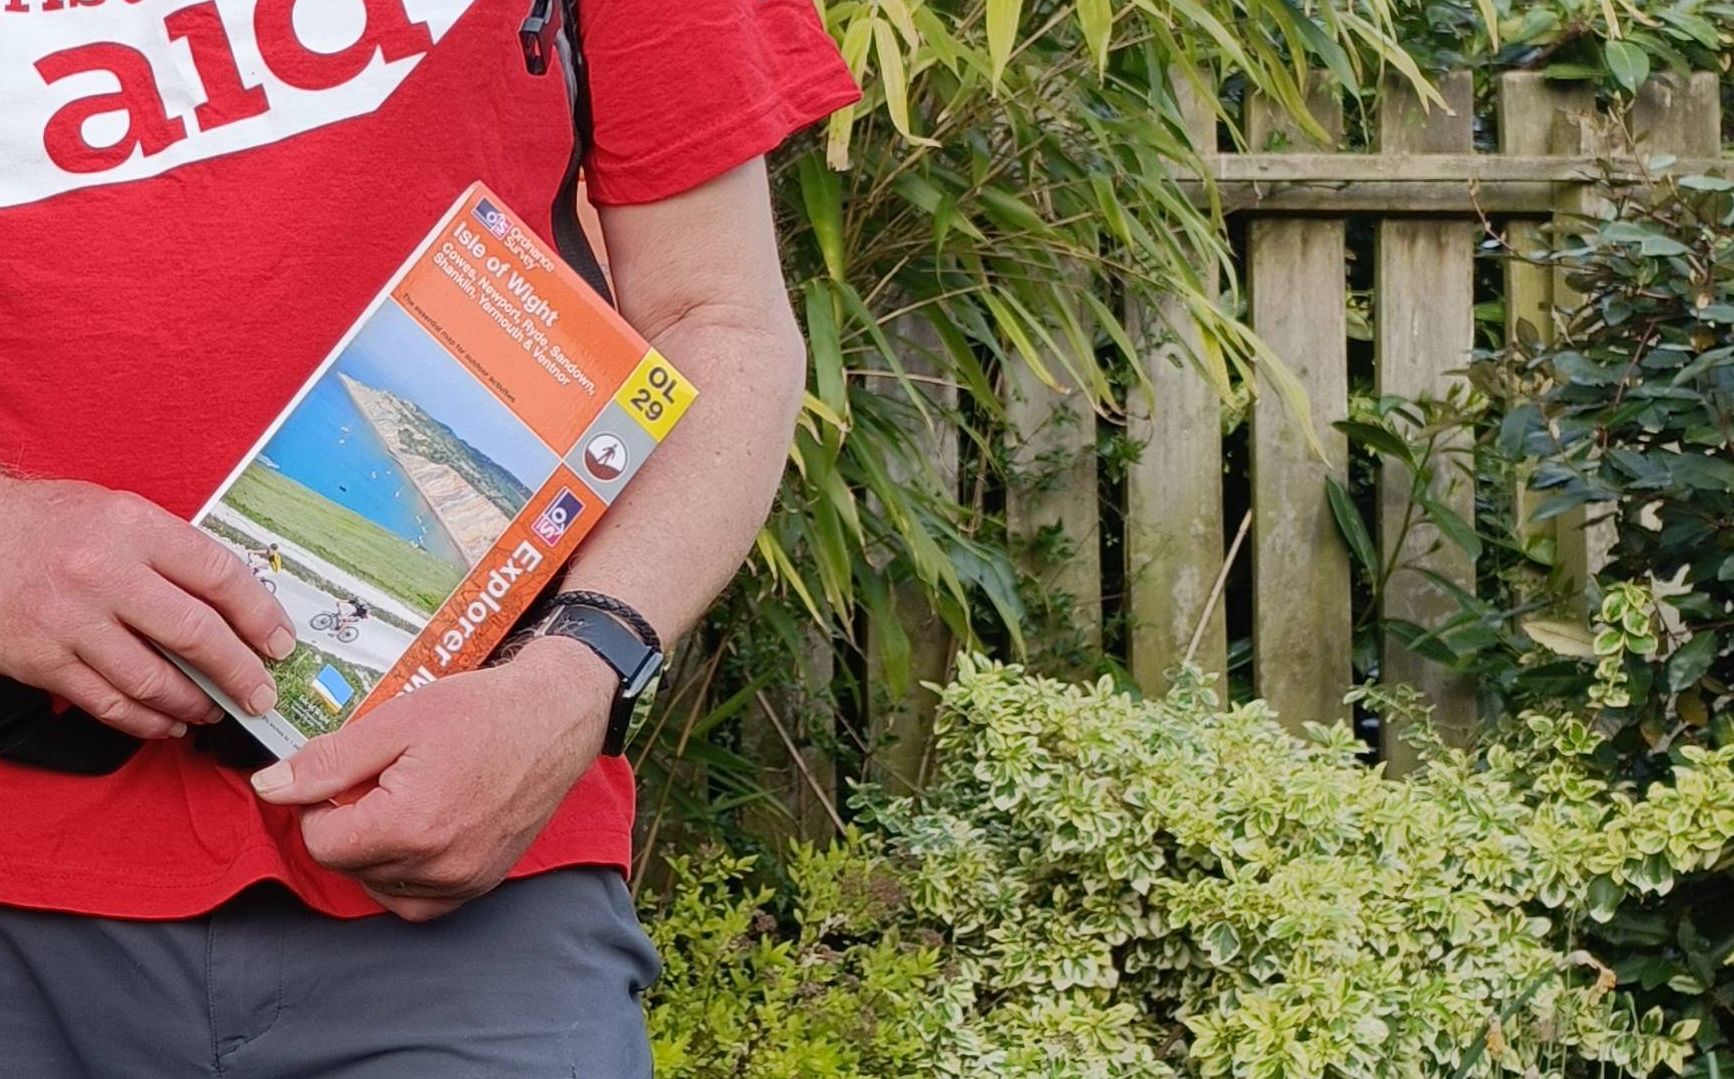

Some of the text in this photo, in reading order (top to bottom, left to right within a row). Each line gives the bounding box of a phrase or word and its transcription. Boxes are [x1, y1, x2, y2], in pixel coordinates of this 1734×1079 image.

[452, 222, 559, 327] Isle of Wight
[504, 235, 540, 270] Survey
[511, 227, 555, 273] Ordnance
[433, 252, 570, 386] Shanklin, Yarmouth & Ventnor
[442, 242, 596, 396] Cowes, Newport, Ryde, Sandown,
[630, 388, 664, 421] 29
[649, 366, 678, 405] OL
[434, 540, 544, 668] Explorer
